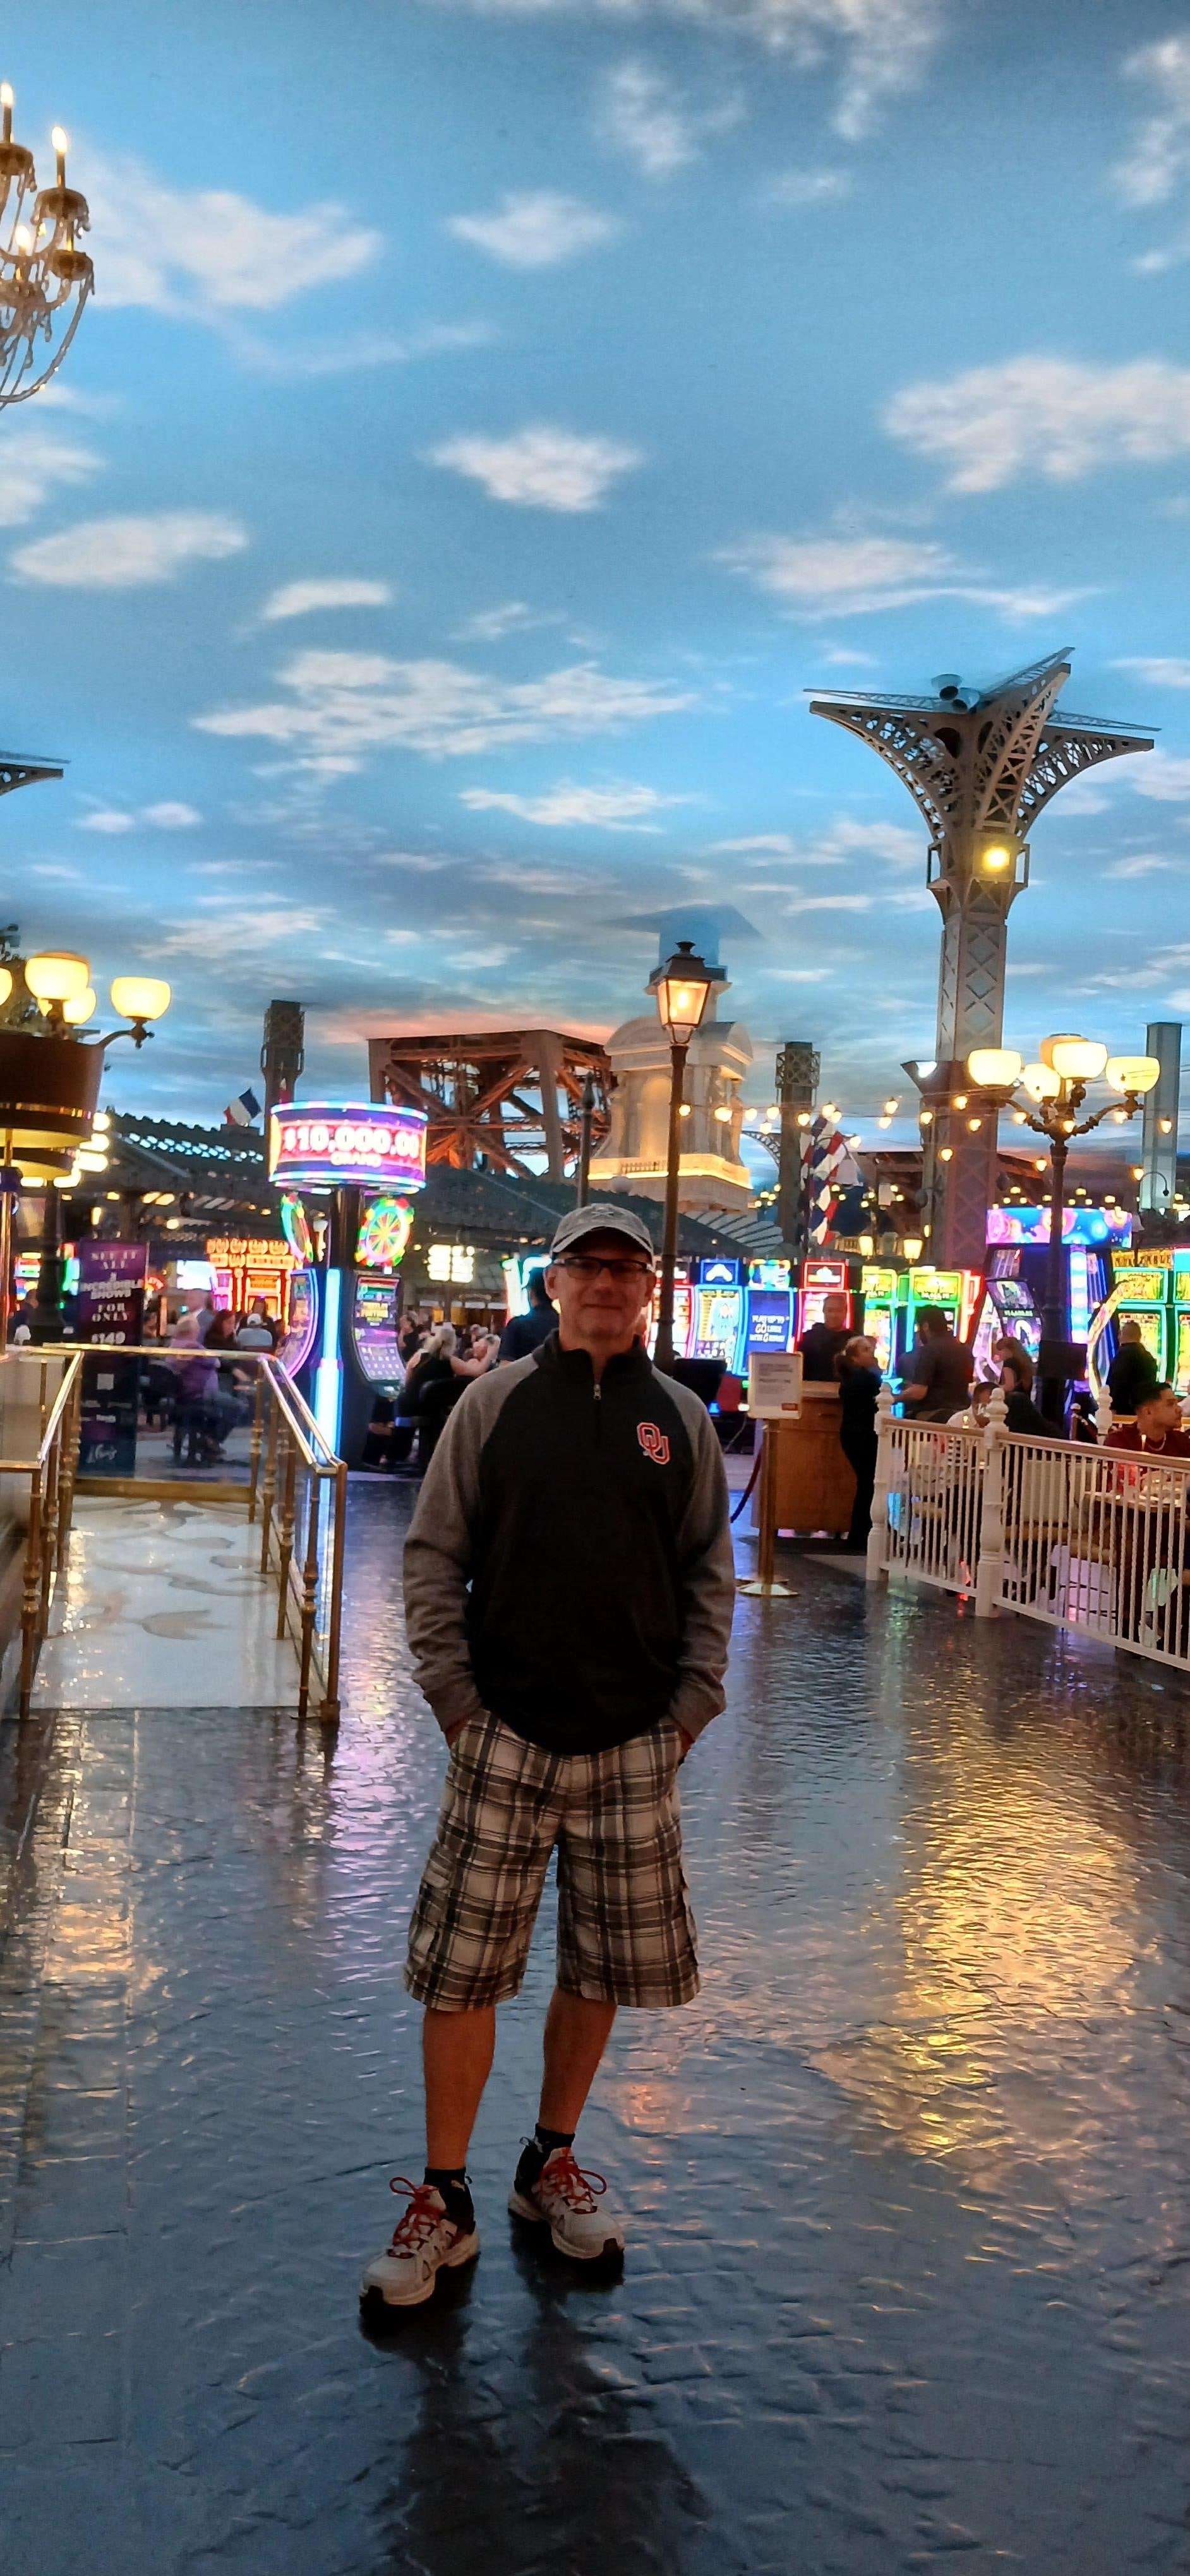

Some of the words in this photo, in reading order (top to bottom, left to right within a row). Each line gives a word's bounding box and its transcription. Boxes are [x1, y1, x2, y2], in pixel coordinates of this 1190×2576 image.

[98, 1303, 126, 1313] FOR
[92, 1312, 128, 1323] ONLY
[637, 1422, 670, 1465] OU
